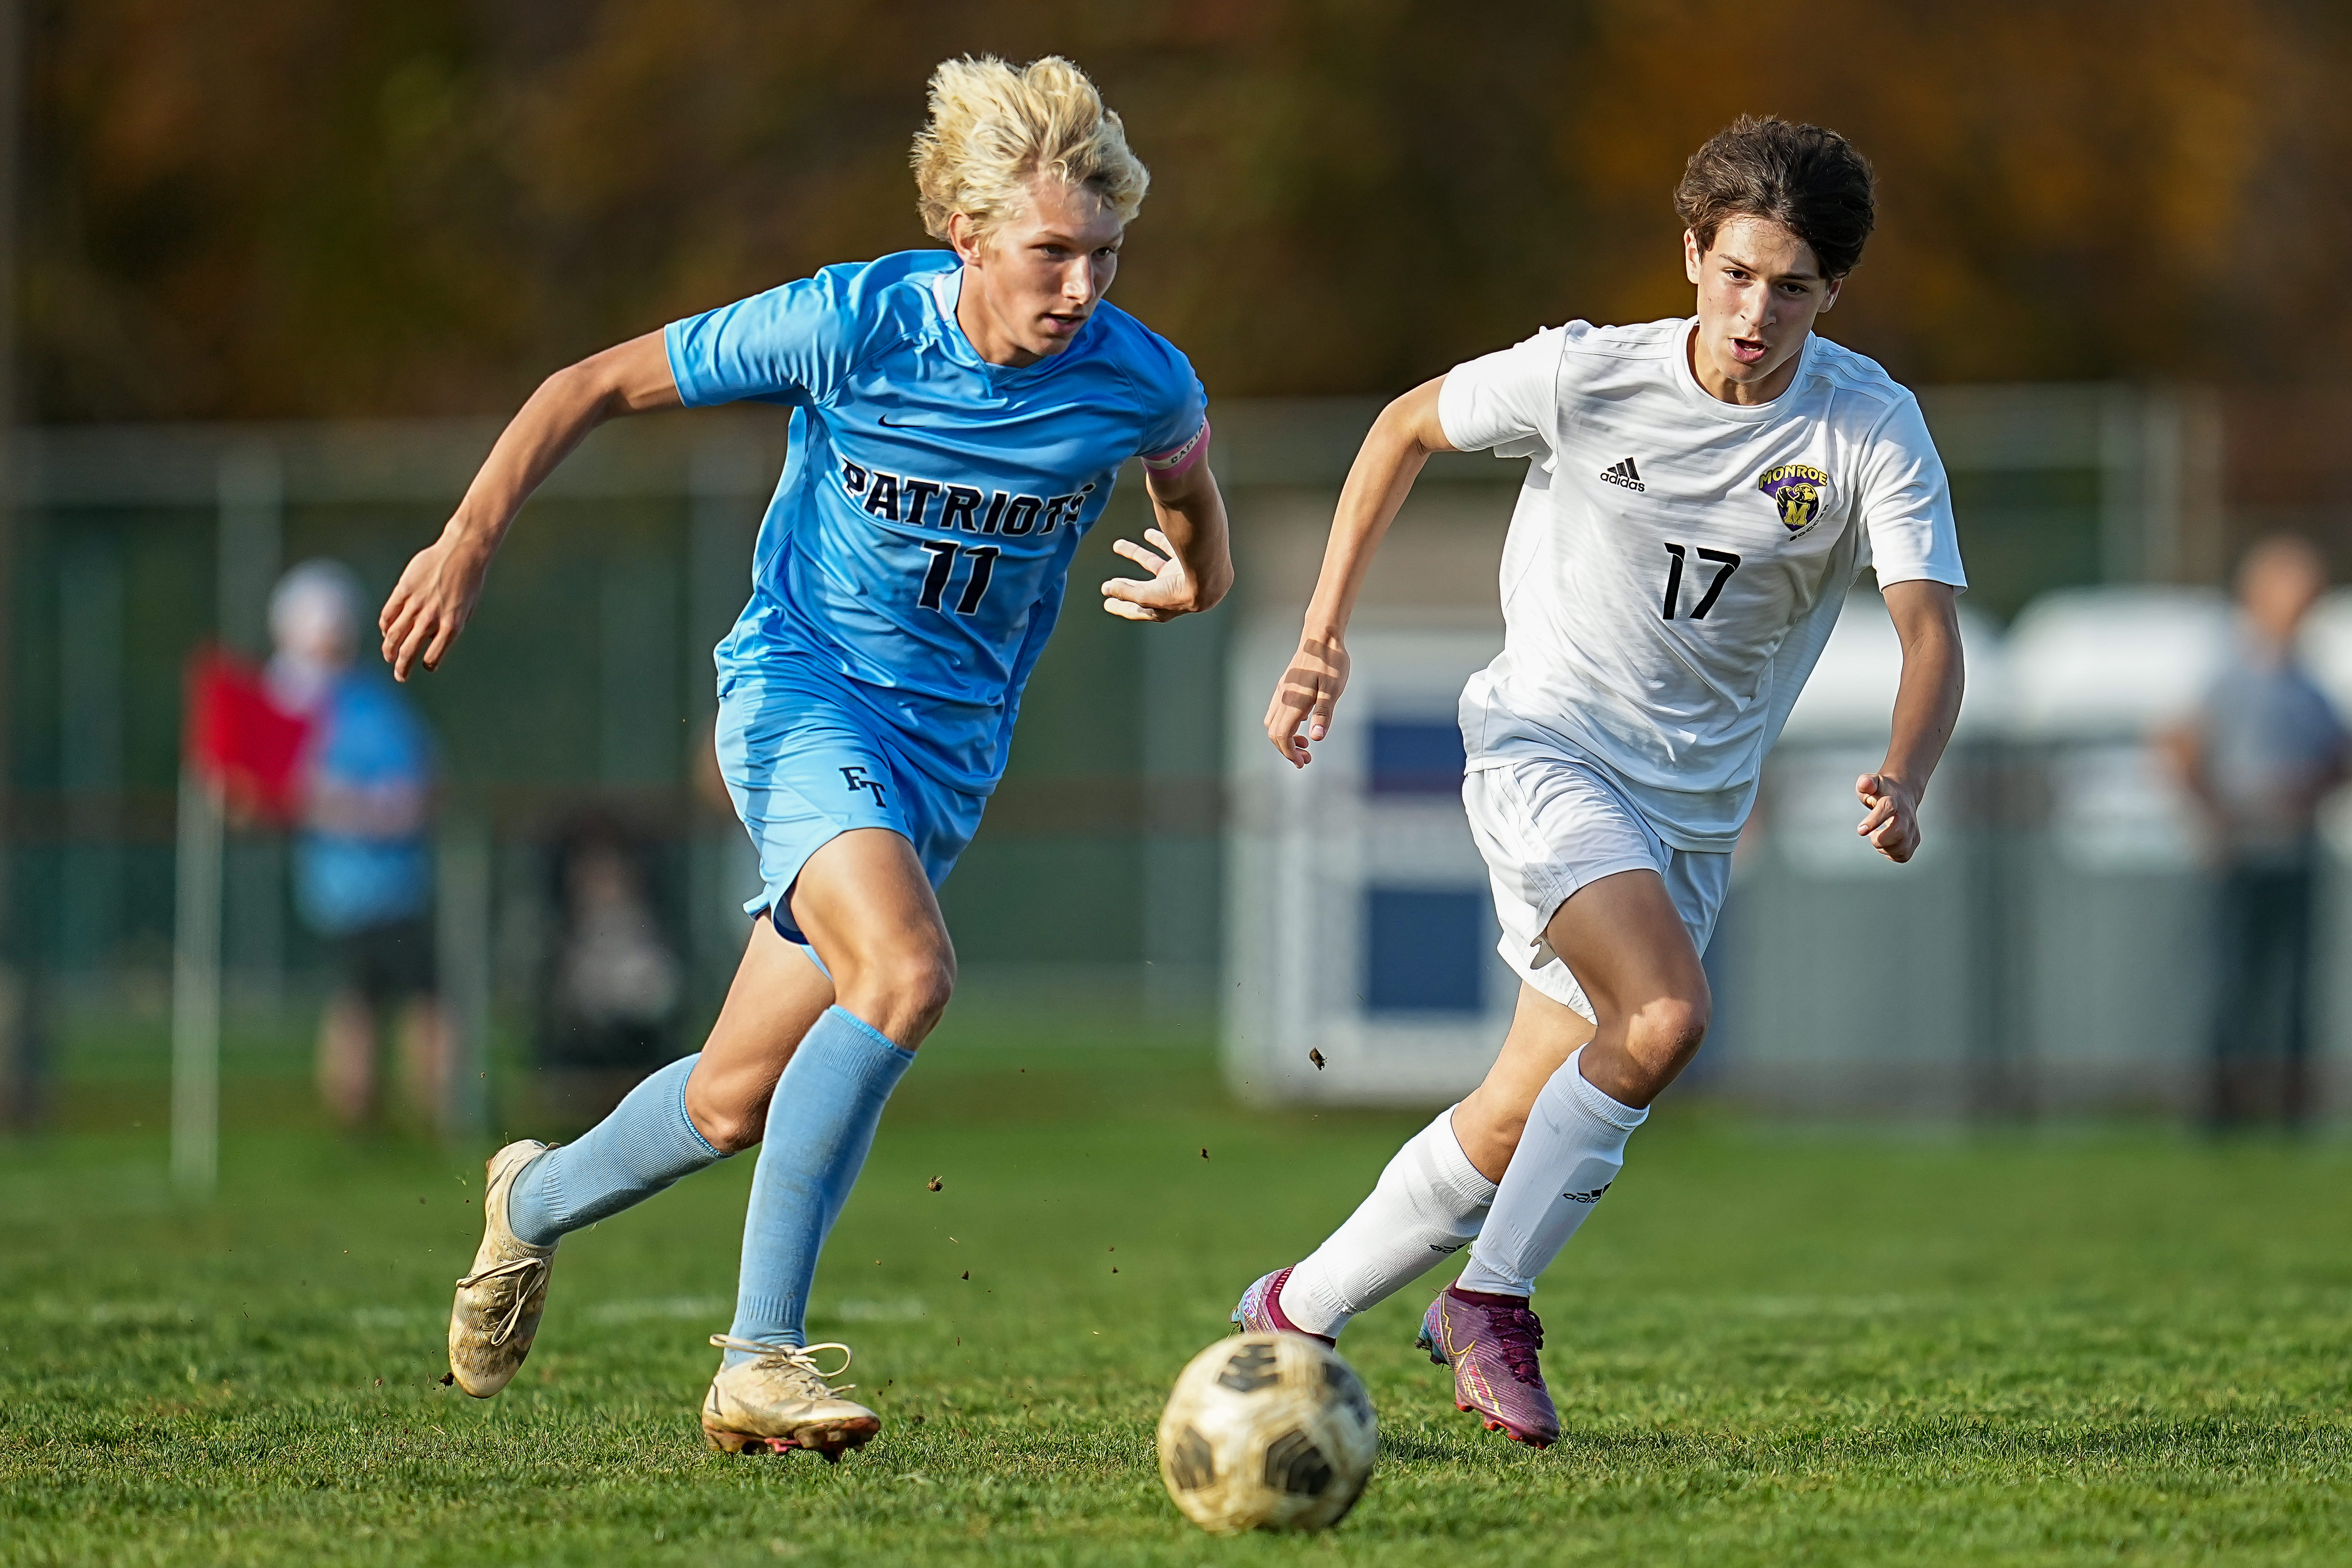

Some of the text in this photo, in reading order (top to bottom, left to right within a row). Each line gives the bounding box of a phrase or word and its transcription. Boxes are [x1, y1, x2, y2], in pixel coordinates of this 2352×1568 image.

[839, 452, 1096, 535] PATRIOTS
[1600, 471, 1646, 492] adidas
[1759, 465, 1828, 489] MONROE
[1784, 500, 1811, 526] M
[1789, 503, 1830, 542] SOCCER
[917, 538, 1001, 616] 11
[1663, 542, 1741, 620] 17
[839, 766, 887, 809] FT
